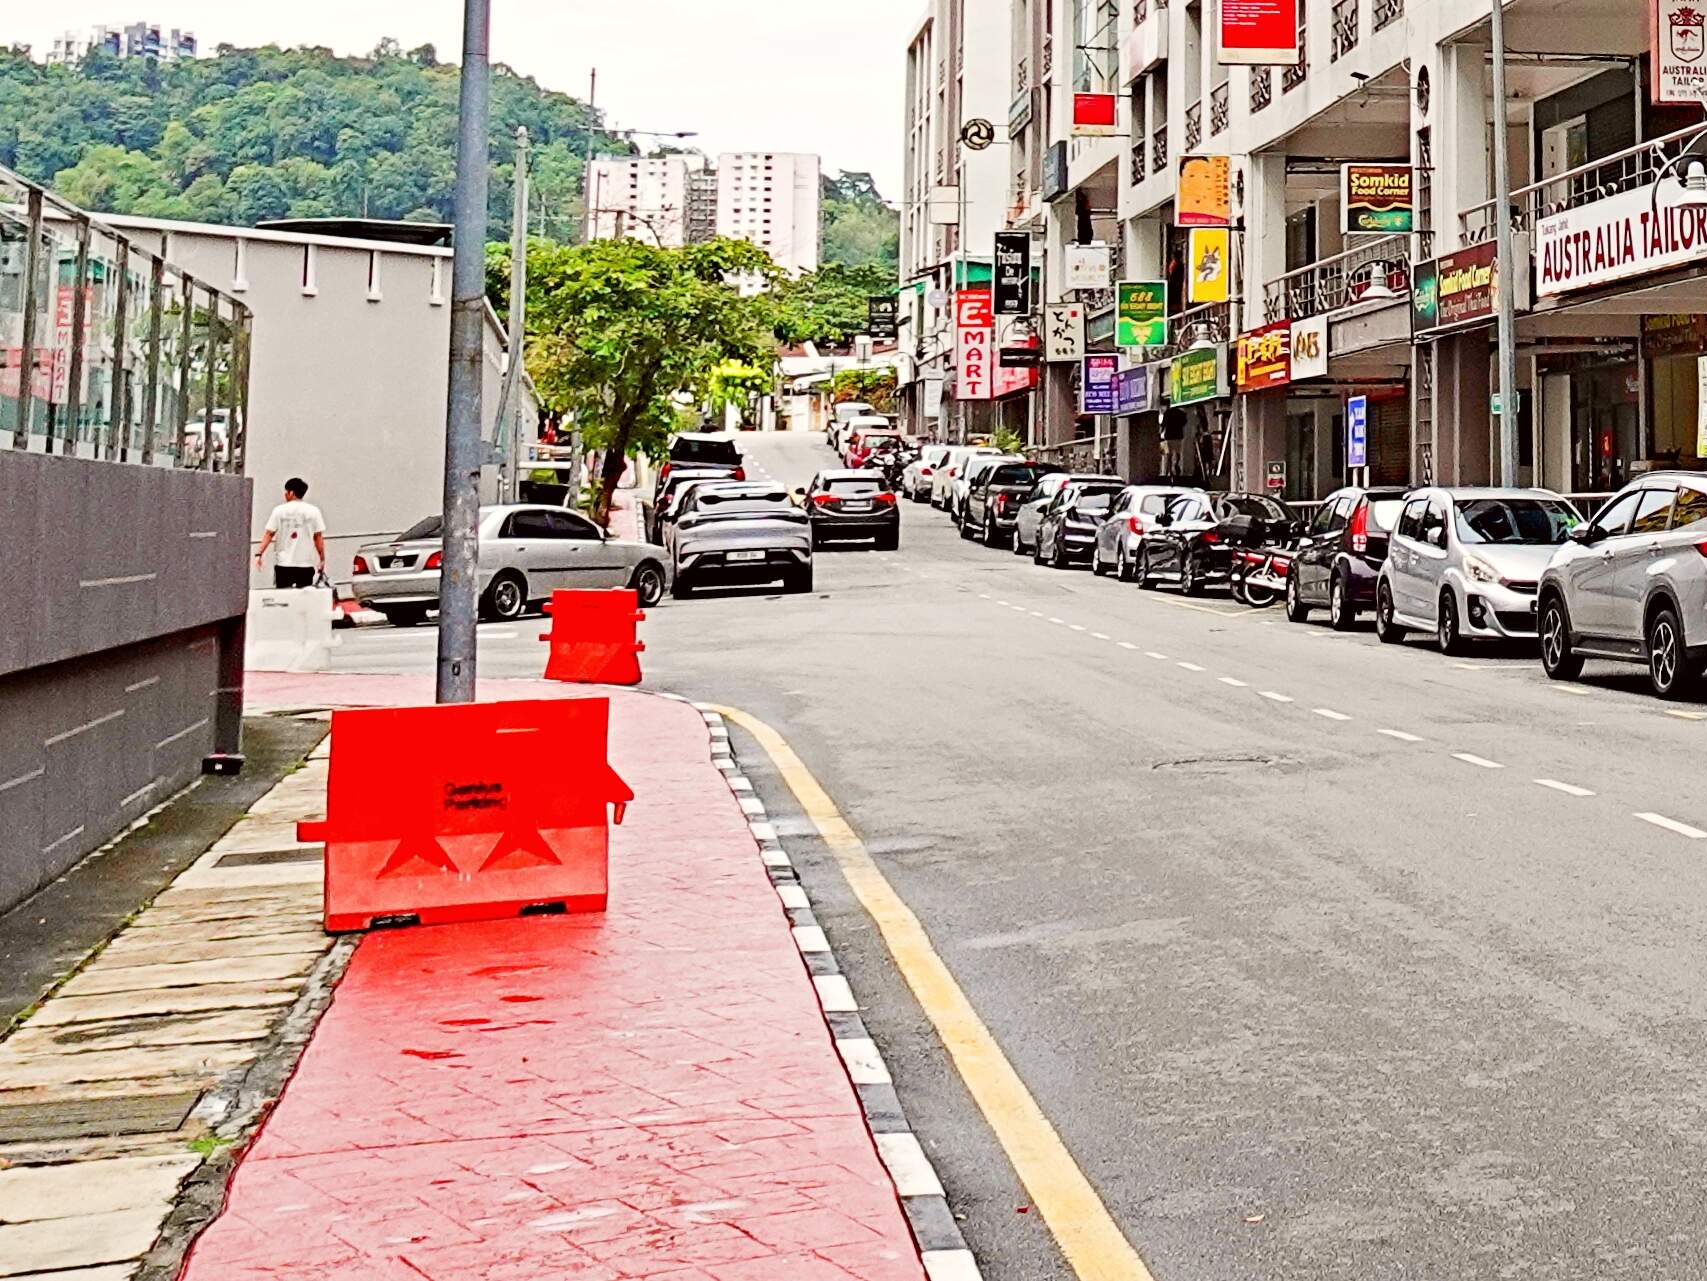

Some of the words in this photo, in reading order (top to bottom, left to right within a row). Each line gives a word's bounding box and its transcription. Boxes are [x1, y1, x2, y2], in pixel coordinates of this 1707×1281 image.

[1350, 173, 1410, 188] Somkid
[1351, 186, 1376, 195] Food
[1376, 186, 1410, 196] Corner
[1542, 217, 1635, 284] AUSTRALIA
[964, 331, 985, 395] MART
